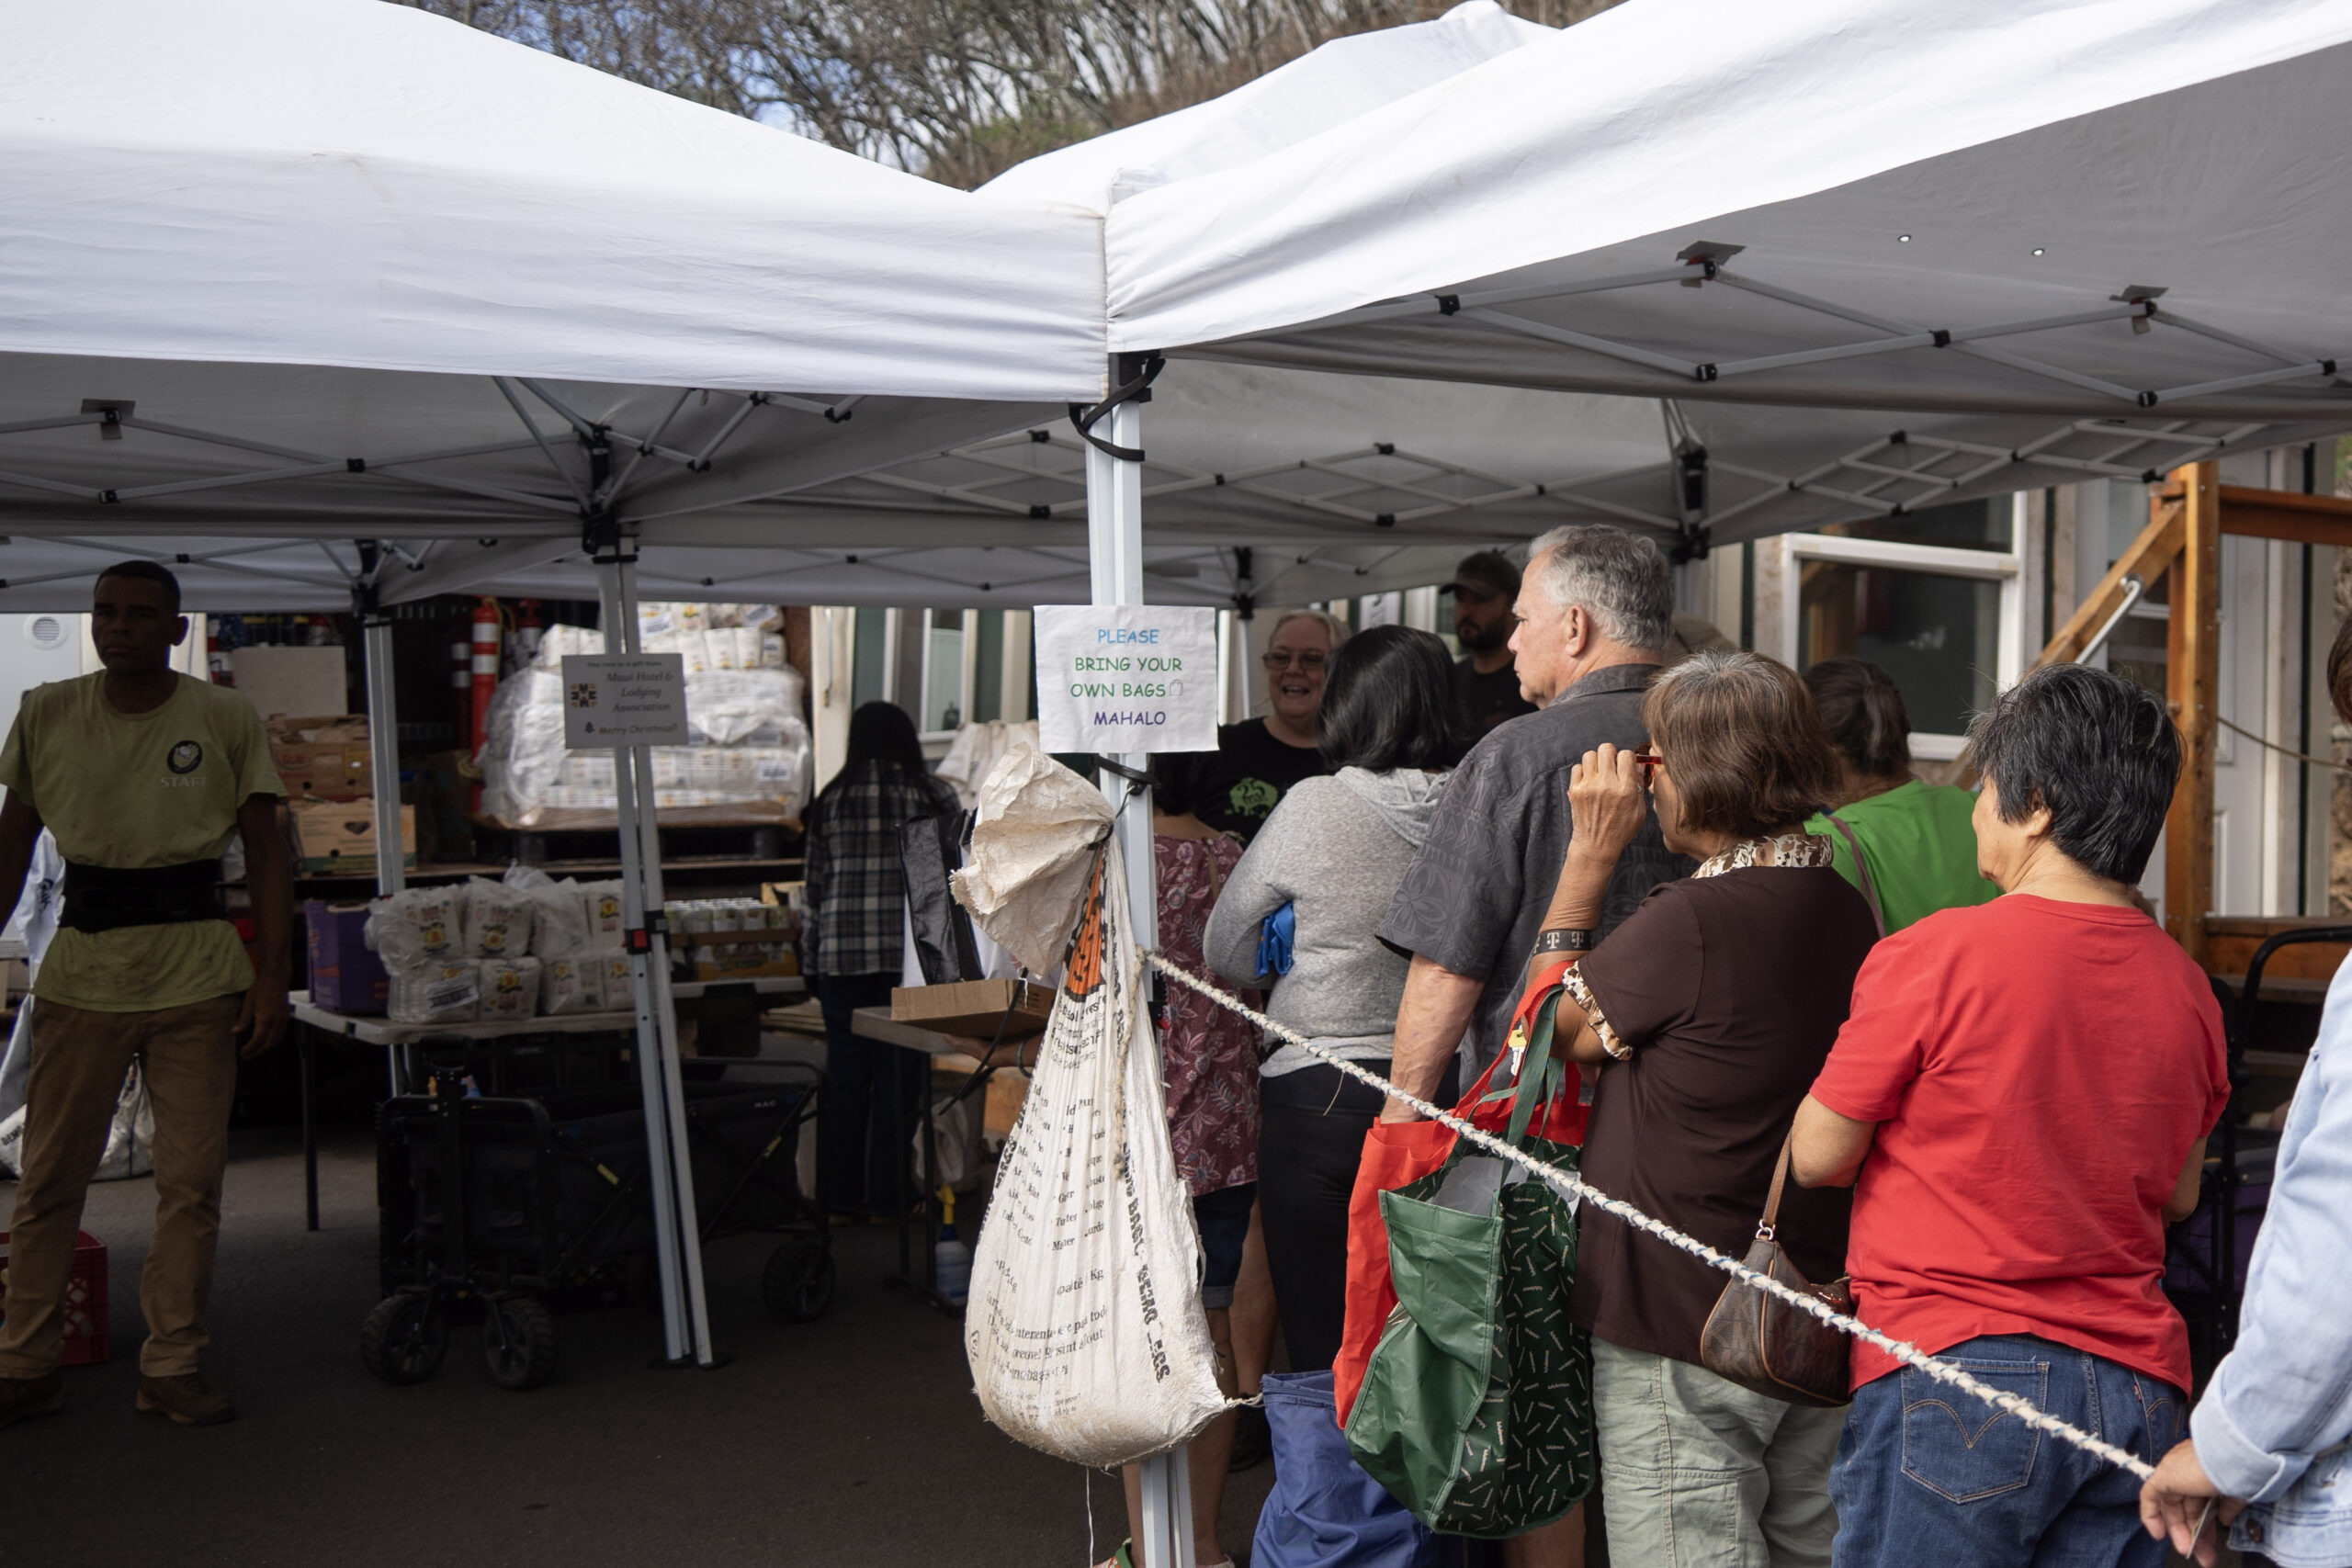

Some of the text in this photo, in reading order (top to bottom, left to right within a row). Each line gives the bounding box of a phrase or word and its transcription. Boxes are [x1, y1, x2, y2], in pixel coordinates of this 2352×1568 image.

[1097, 628, 1160, 644] PLEASE
[1074, 657, 1182, 671] BRING YOUR
[606, 672, 633, 682] Maui
[635, 671, 663, 682] Hotel
[620, 687, 662, 698] Lodging
[1070, 682, 1166, 698] OWN BAGS
[611, 703, 672, 713] Association
[1093, 711, 1167, 726] MAHALO
[160, 776, 209, 788] STAFF
